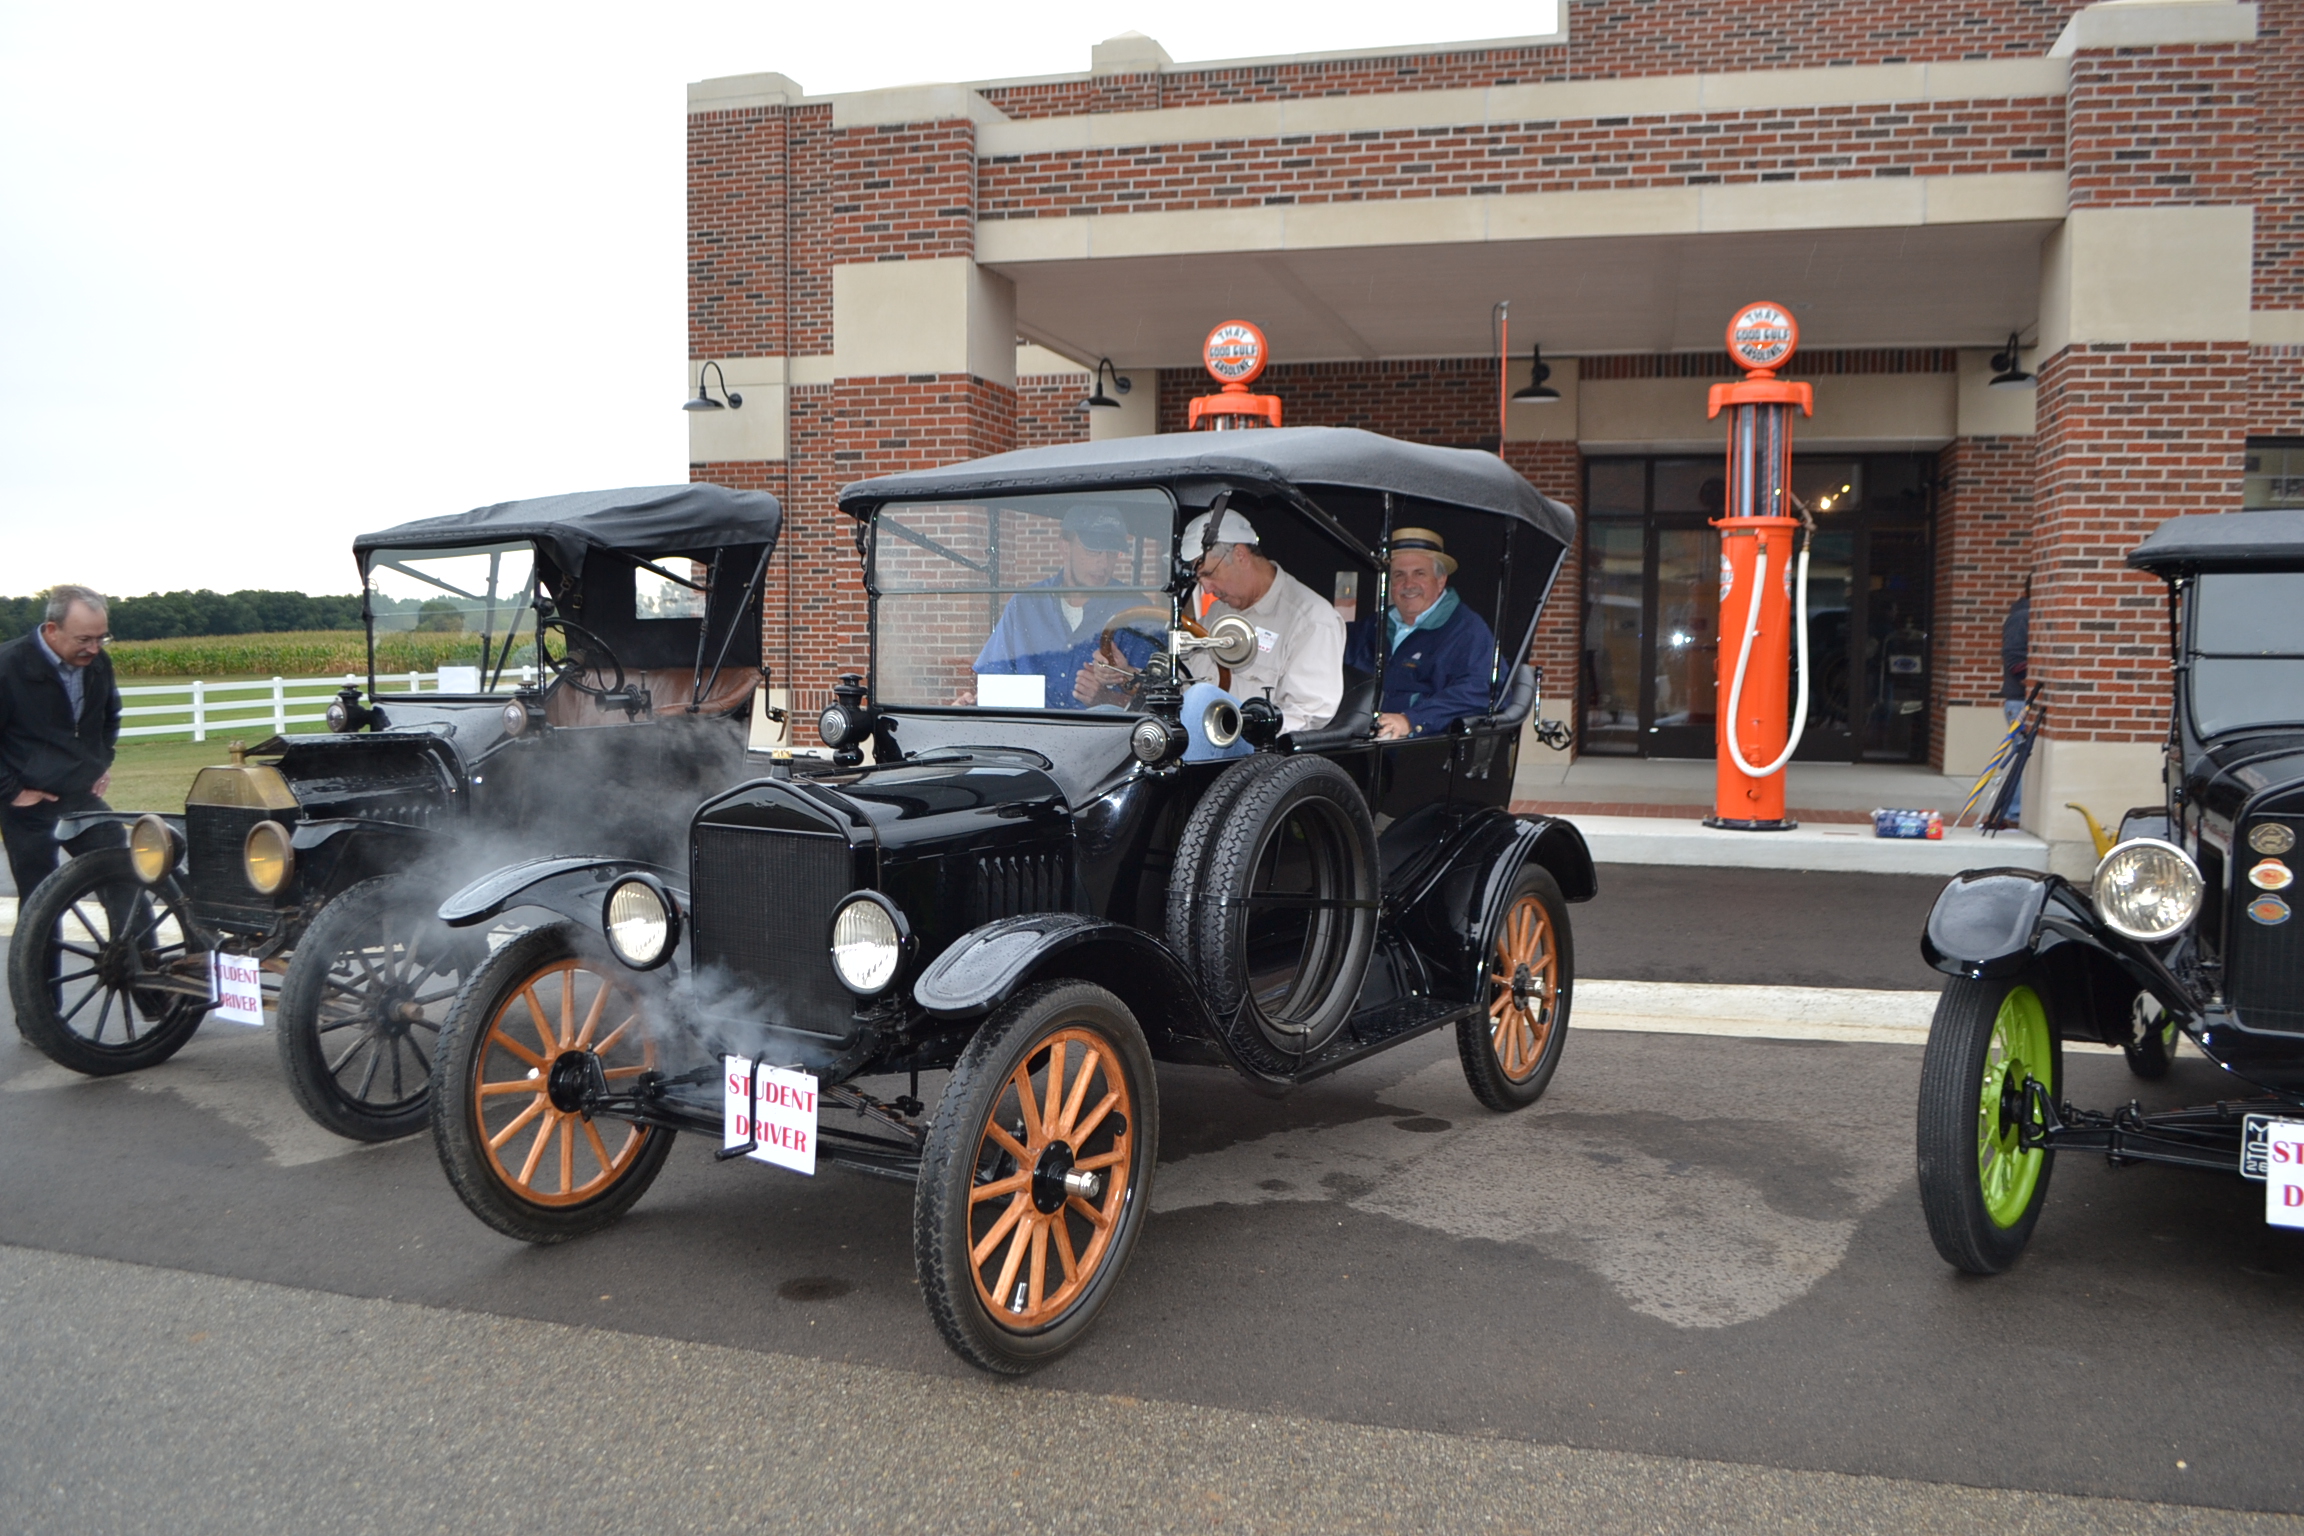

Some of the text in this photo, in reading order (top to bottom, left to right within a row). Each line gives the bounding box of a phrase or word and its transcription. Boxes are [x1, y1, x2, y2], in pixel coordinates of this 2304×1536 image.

[1745, 309, 1781, 323] THAT
[1217, 327, 1248, 340] THAT
[1736, 328, 1790, 341] GOOD GULF
[1209, 344, 1257, 357] GOOD GULF
[1740, 344, 1784, 362] GASOLINE
[1214, 360, 1252, 376] GASOLINE
[728, 1073, 816, 1113] STUDENT
[735, 1114, 808, 1153] DRIVER
